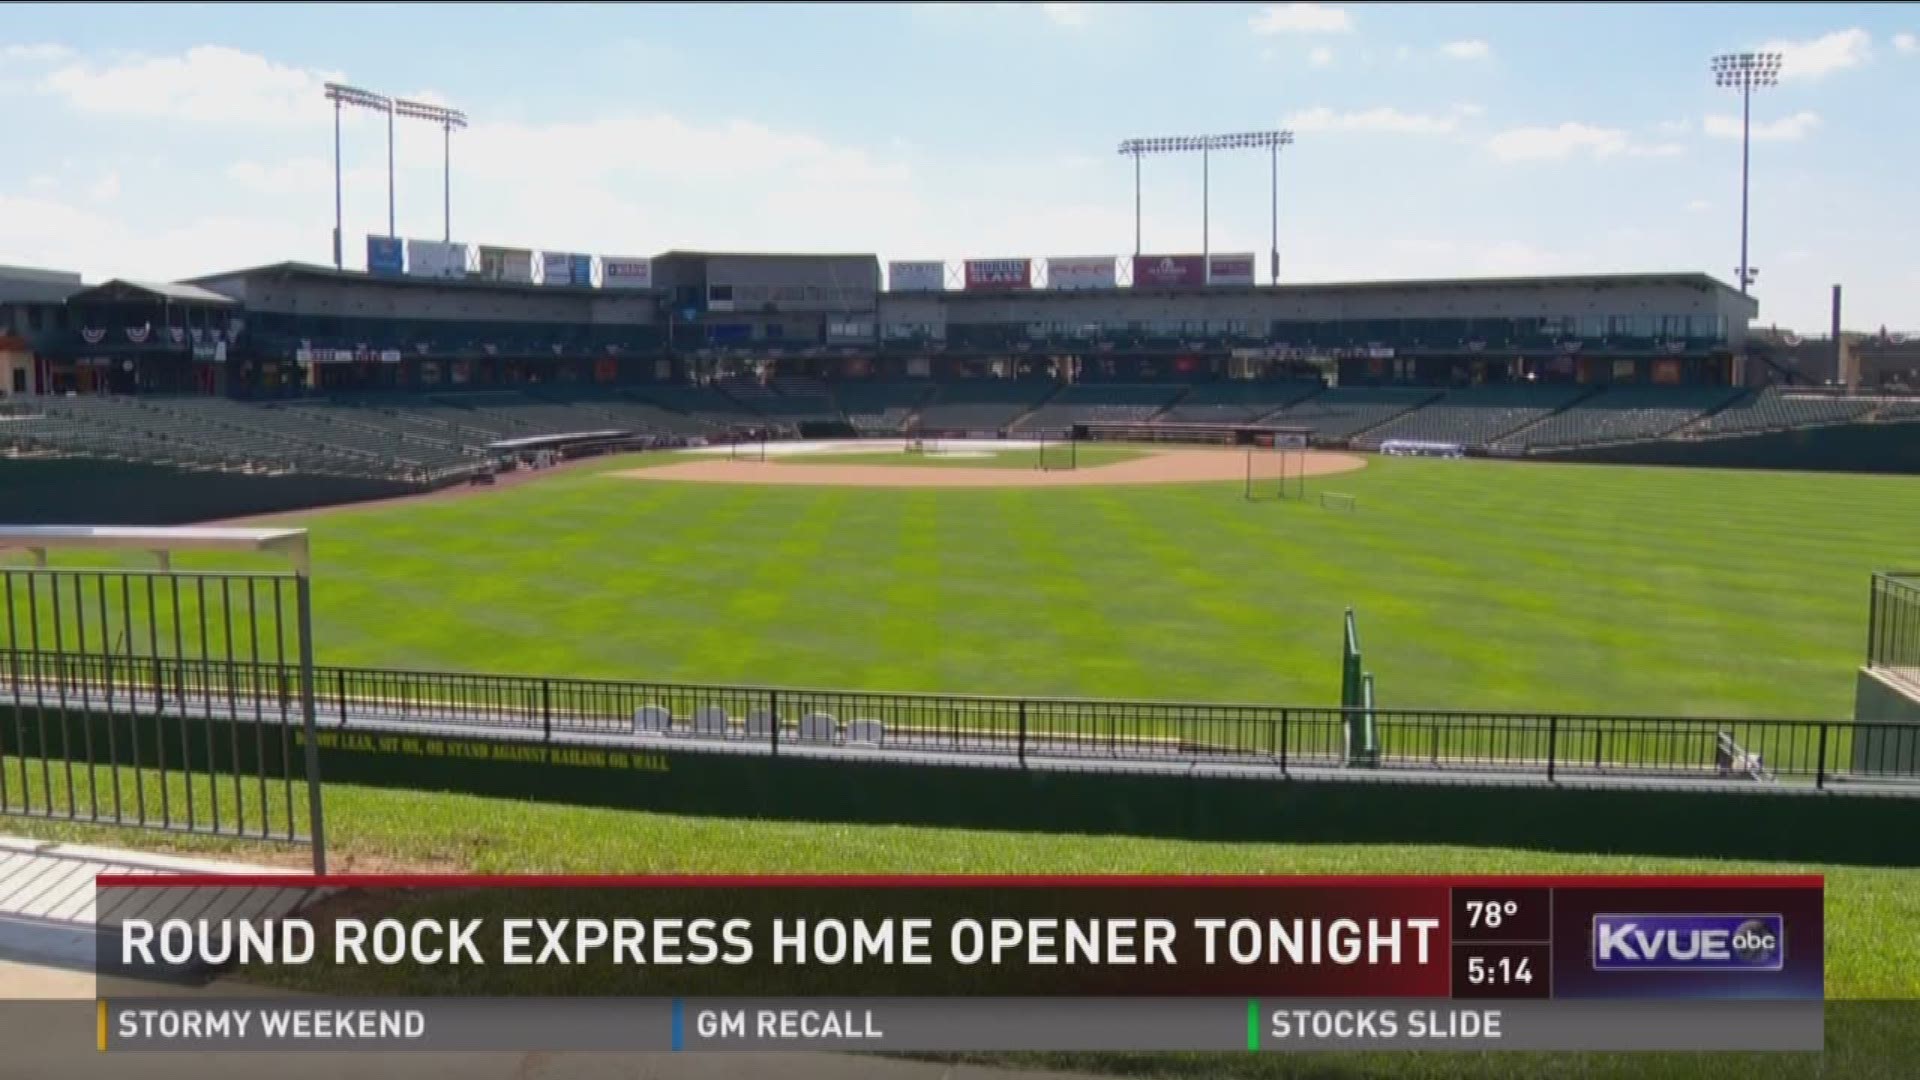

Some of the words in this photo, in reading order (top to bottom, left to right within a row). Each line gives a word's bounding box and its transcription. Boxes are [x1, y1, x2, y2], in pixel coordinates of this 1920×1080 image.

[341, 734, 375, 753] LEAN,
[379, 737, 399, 753] SIT
[447, 742, 488, 758] STAND
[491, 744, 546, 763] AGAINST
[551, 748, 605, 768] RAILING
[633, 755, 671, 772] WALL
